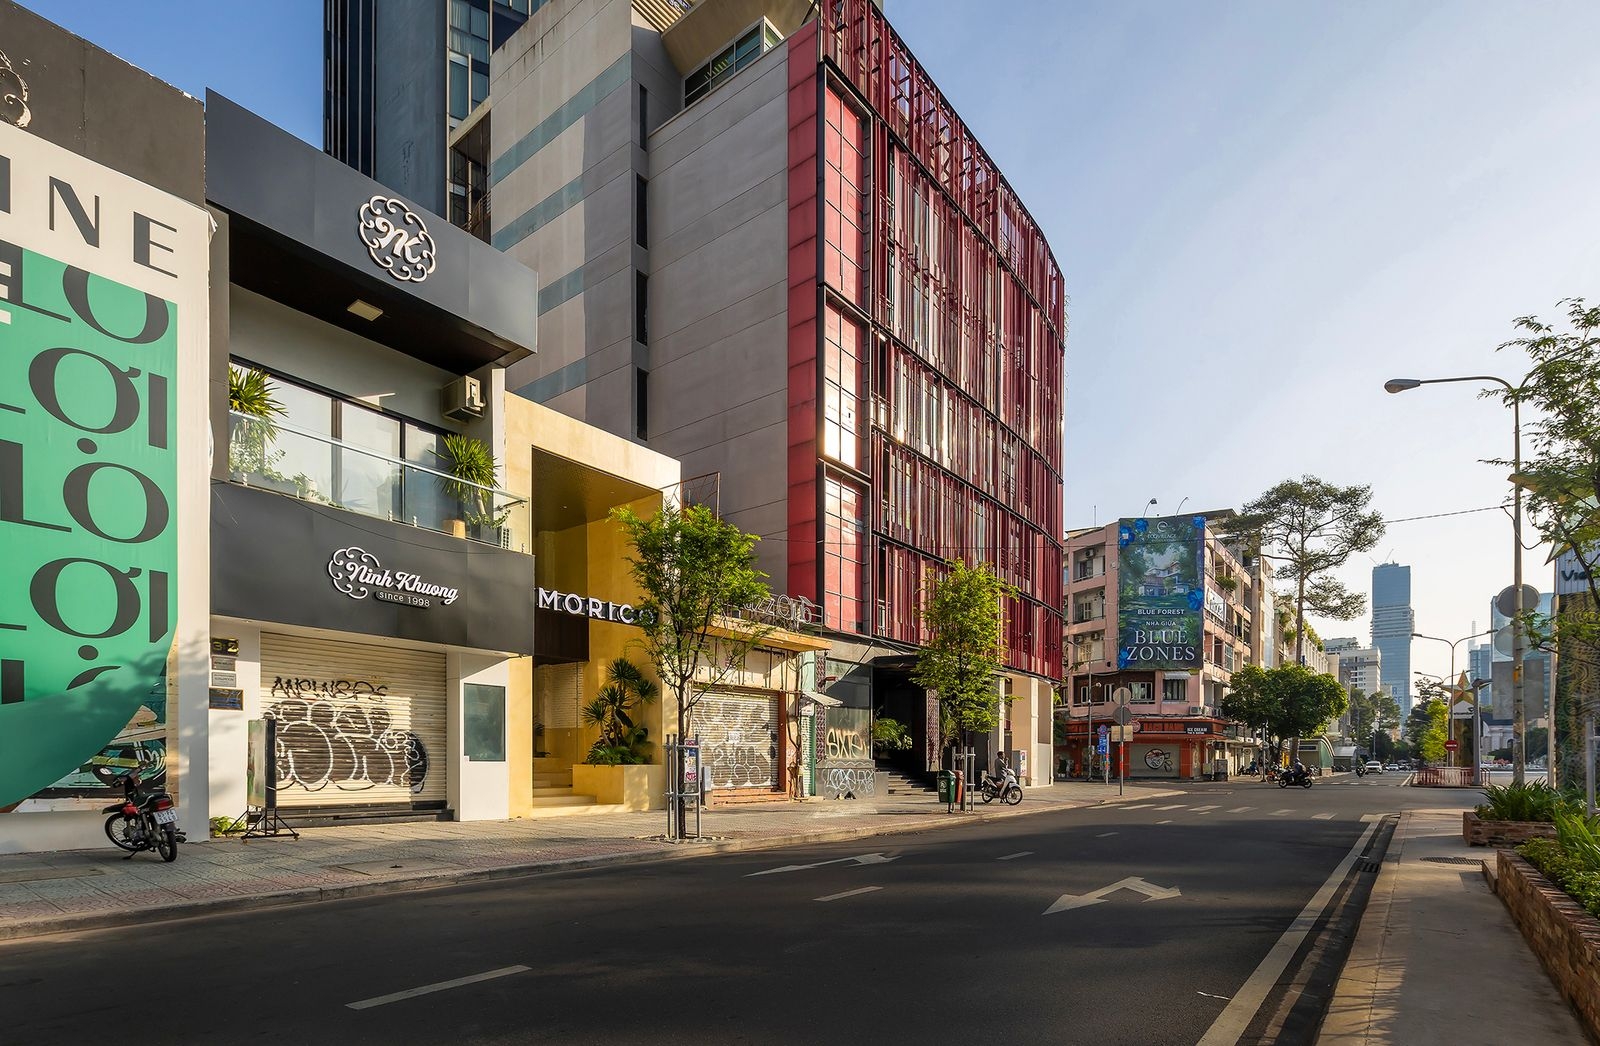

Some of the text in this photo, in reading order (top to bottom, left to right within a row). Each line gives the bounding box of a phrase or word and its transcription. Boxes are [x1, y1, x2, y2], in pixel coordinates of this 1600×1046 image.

[345, 561, 458, 605] Ninh Khuong
[379, 591, 430, 607] since 1998
[1135, 630, 1188, 644] BLUE
[1126, 646, 1195, 661] ZONES
